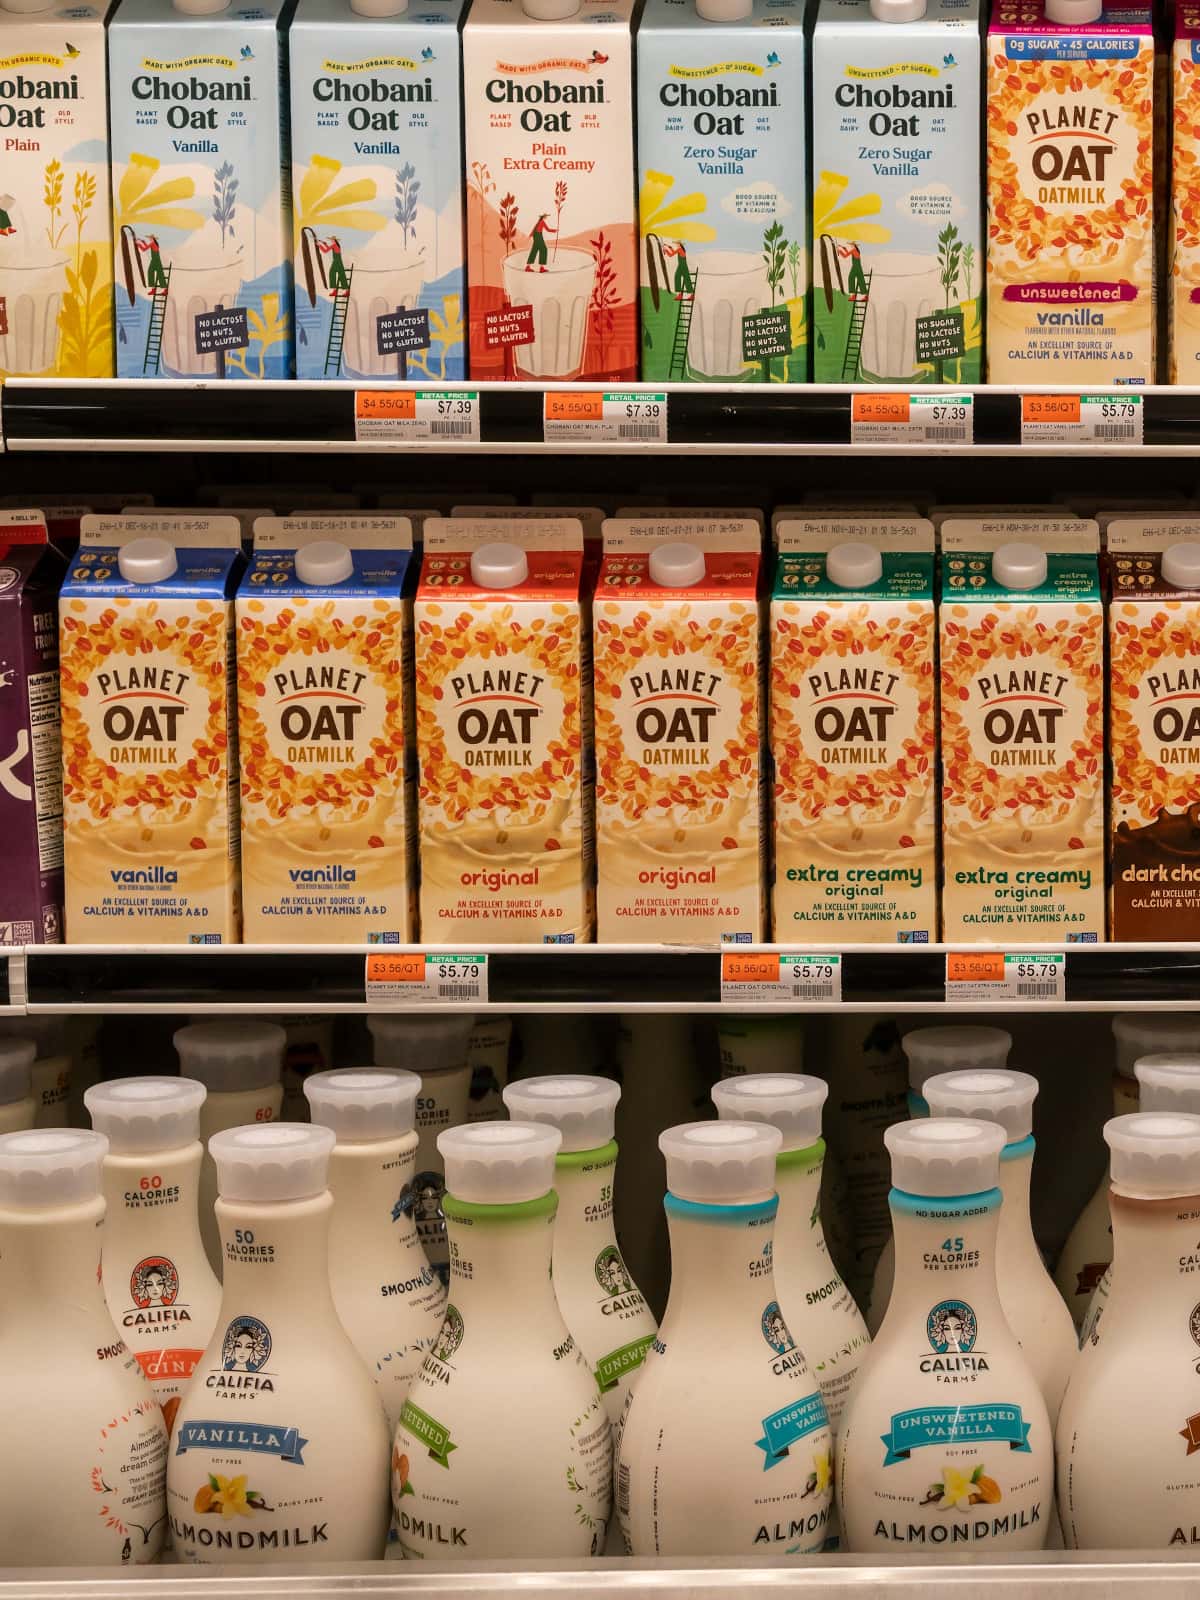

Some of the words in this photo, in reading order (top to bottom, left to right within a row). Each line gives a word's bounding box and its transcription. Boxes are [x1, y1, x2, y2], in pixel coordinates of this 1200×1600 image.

[131, 76, 250, 100] Chobani
[313, 77, 432, 102] Chobani
[485, 79, 605, 103] Chobani
[659, 83, 778, 107] Chobani
[835, 84, 954, 108] Chobani
[166, 106, 217, 130] Oat
[348, 107, 399, 131] Oat
[520, 108, 571, 132] Oat
[693, 112, 744, 135] Oat
[868, 113, 919, 136] Oat
[1026, 106, 1119, 132] PLANET
[5, 139, 40, 151] Plain
[172, 141, 218, 154] Vanilla
[354, 142, 400, 155] Vanilla
[532, 143, 566, 156] Plain
[683, 146, 715, 158] Zero
[717, 146, 757, 161] Sugar
[858, 147, 889, 159] Zero
[893, 147, 932, 162] Sugar
[503, 158, 539, 170] Extra
[542, 158, 596, 173] Creamy
[698, 162, 744, 175] Vanilla
[872, 164, 919, 176] Vanilla
[1032, 146, 1113, 182] OAT
[1039, 187, 1105, 203] OATMILK
[1020, 286, 1121, 300] unsweetened
[200, 319, 210, 328] NO
[212, 315, 244, 326] LACTOSE
[1037, 310, 1104, 327] vanilla
[201, 330, 211, 338] NO
[213, 328, 233, 337] NUTS
[201, 340, 212, 349] NO
[214, 336, 242, 348] GLUTEN
[1008, 351, 1051, 360] CALCIUM
[1063, 350, 1106, 360] VITAMINS
[438, 400, 471, 414] $7.39
[627, 405, 660, 417] $7.39
[933, 407, 965, 420] $7.39
[1102, 404, 1135, 417] $5.79
[98, 666, 190, 695] PLANET
[274, 666, 367, 695] PLANET
[451, 670, 545, 698] PLANET
[808, 668, 900, 697] PLANET
[103, 706, 185, 742] OAT
[280, 705, 363, 741] OAT
[457, 709, 541, 745] OAT
[814, 707, 895, 742] OAT
[110, 747, 177, 763] OATMILK
[111, 866, 178, 884] vanilla
[289, 866, 356, 883] vanilla
[461, 868, 539, 892] original
[638, 867, 715, 890] original
[786, 867, 839, 882] extra
[846, 867, 922, 887] creamy
[955, 869, 1007, 884] extra
[1015, 869, 1091, 890] creamy
[1122, 863, 1167, 882] dark
[825, 885, 884, 901] original
[994, 887, 1053, 902] original
[439, 965, 479, 978] $5.79
[793, 965, 833, 978] $5.79
[1018, 964, 1057, 977] $5.79
[140, 1176, 161, 1189] 60
[125, 1185, 179, 1201] CALORIES
[930, 1209, 959, 1218] SUGAR
[962, 1207, 988, 1216] ADDED
[235, 1230, 254, 1244] 50
[122, 1309, 191, 1328] CALIFIA
[920, 1356, 989, 1373] CALIFIA
[205, 1374, 273, 1392] CALIFIA
[900, 1412, 1015, 1429] UNSWEETENED
[926, 1424, 994, 1436] VANILLA
[188, 1429, 279, 1449] VANILLA
[874, 1502, 1041, 1543] ALMONDMILK
